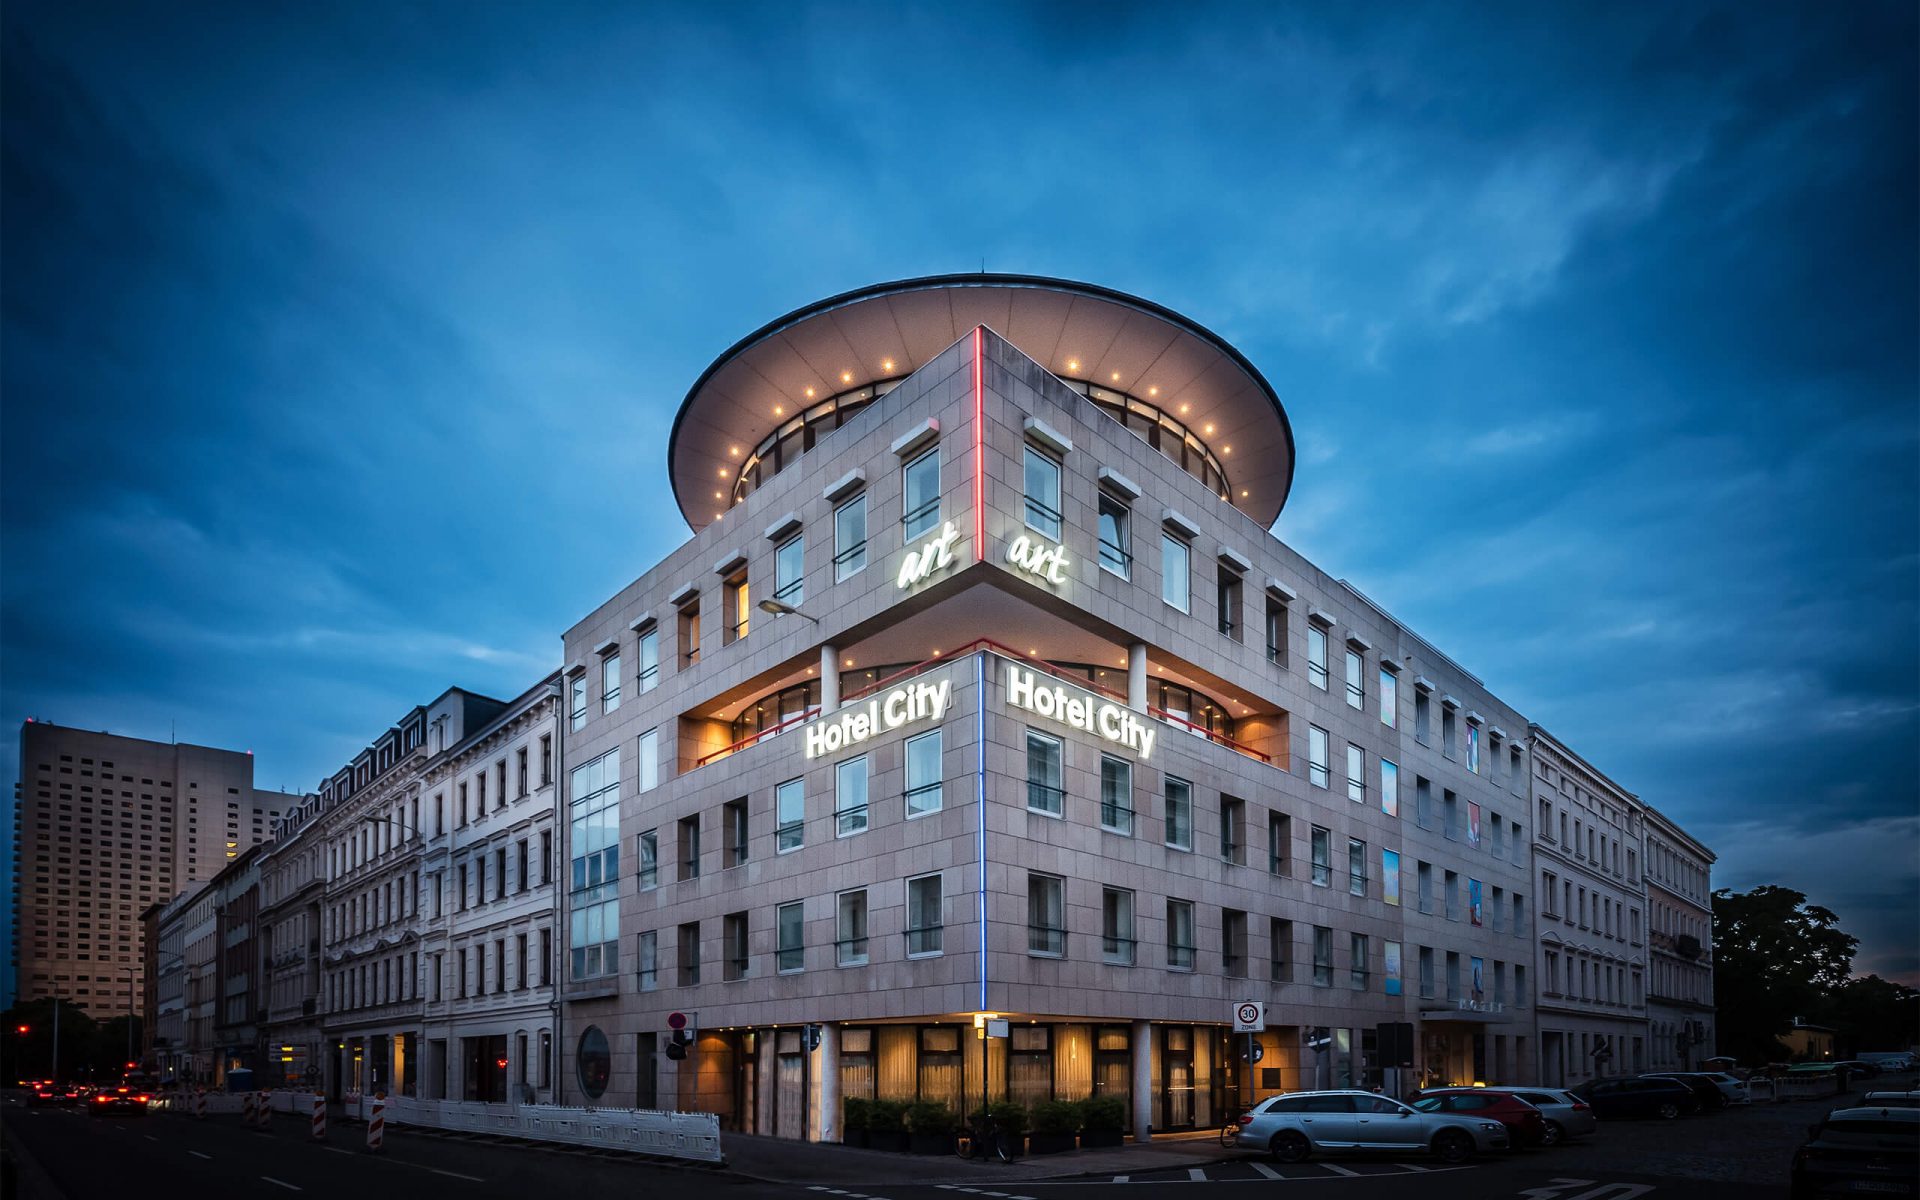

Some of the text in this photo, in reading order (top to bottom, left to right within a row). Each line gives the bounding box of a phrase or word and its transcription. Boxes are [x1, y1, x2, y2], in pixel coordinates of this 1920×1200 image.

[897, 521, 960, 588] art
[1008, 535, 1070, 584] art
[806, 679, 950, 759] Hotel City
[1009, 666, 1155, 759] Hotel City
[1242, 1009, 1255, 1019] 30
